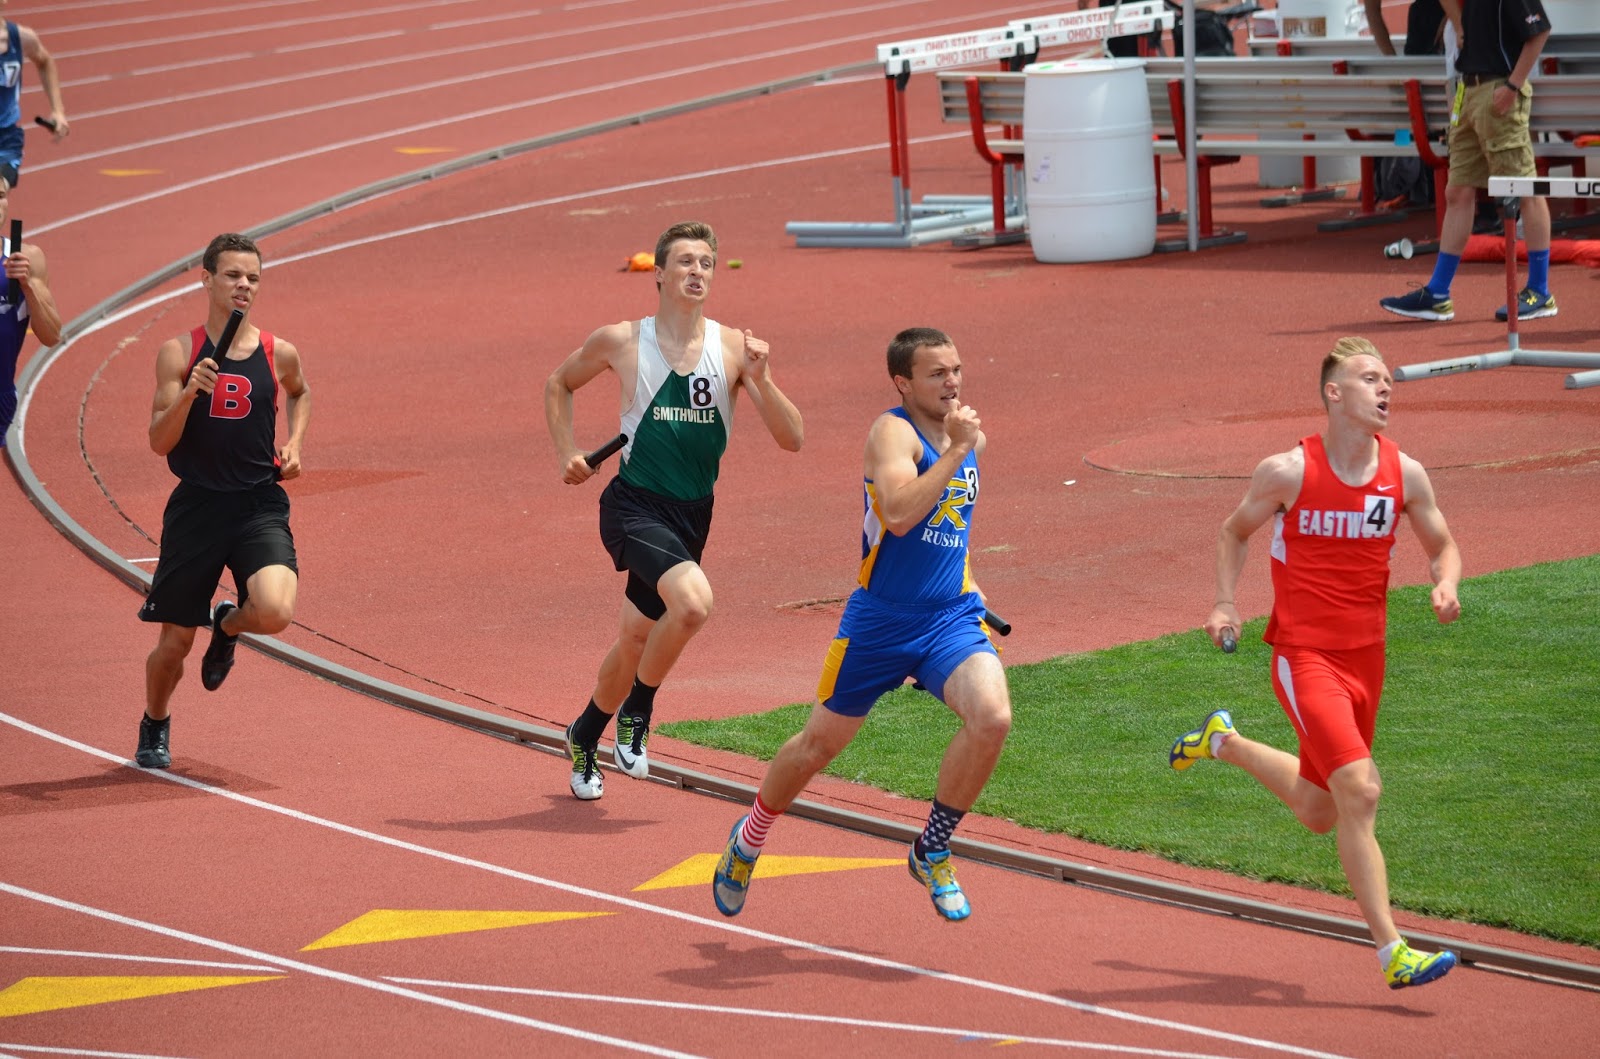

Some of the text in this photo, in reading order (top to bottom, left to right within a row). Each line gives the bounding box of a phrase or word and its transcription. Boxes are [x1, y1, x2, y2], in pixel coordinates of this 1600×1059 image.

[1067, 28, 1092, 41] OHIO
[1095, 23, 1124, 39] STTE
[935, 51, 958, 66] OHIO
[962, 47, 989, 62] STATE
[7, 65, 17, 86] 7
[209, 372, 252, 419] B
[693, 377, 712, 407] 8
[653, 406, 715, 423] SMITHVILLE
[967, 470, 977, 502] 3
[1298, 509, 1395, 539] EASTW
[1366, 499, 1387, 531] 4
[921, 528, 964, 548] RUSSIA
